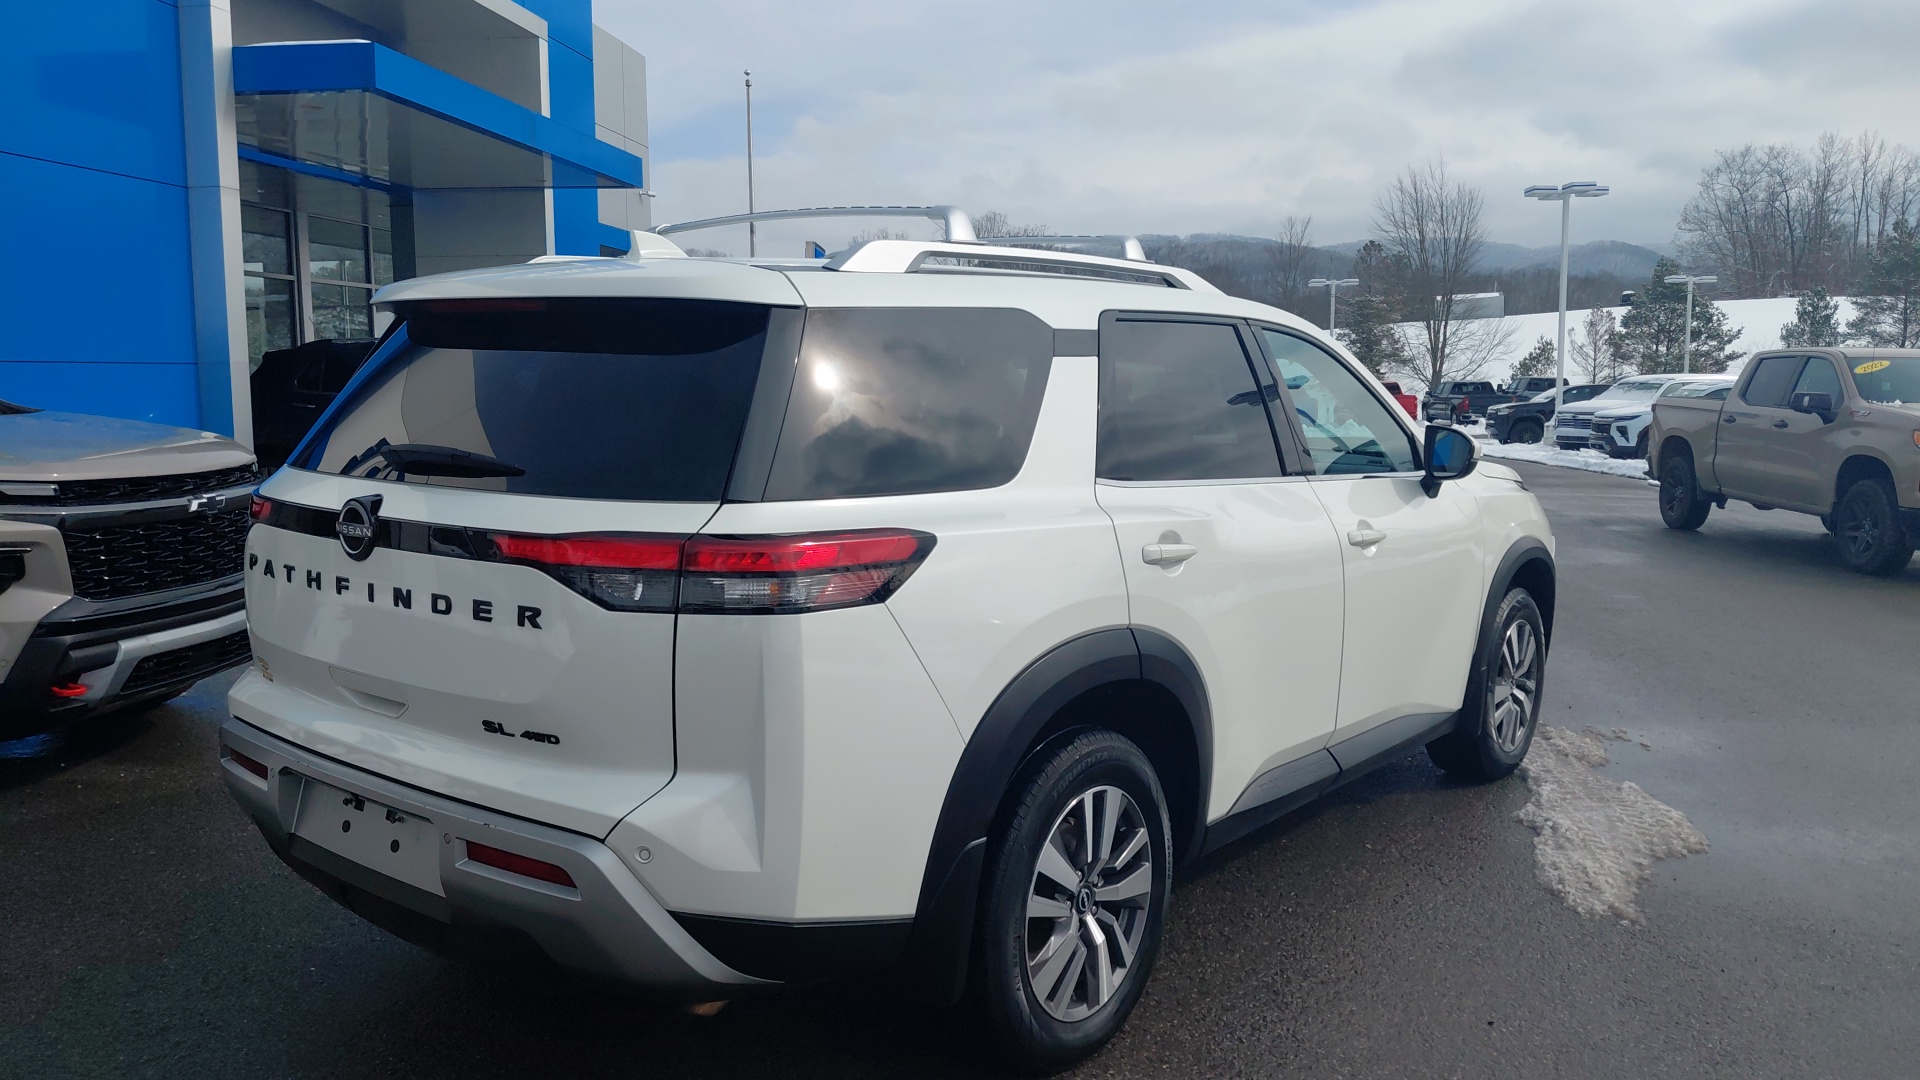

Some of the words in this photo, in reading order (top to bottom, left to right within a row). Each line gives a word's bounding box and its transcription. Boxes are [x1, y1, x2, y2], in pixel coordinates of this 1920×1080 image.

[1861, 361, 1885, 372] 2022
[336, 522, 371, 537] NISSAN
[249, 552, 542, 629] PATHFINDER
[481, 719, 516, 738] SL
[519, 730, 560, 745] 4WD
[1014, 971, 1022, 992] ALL
